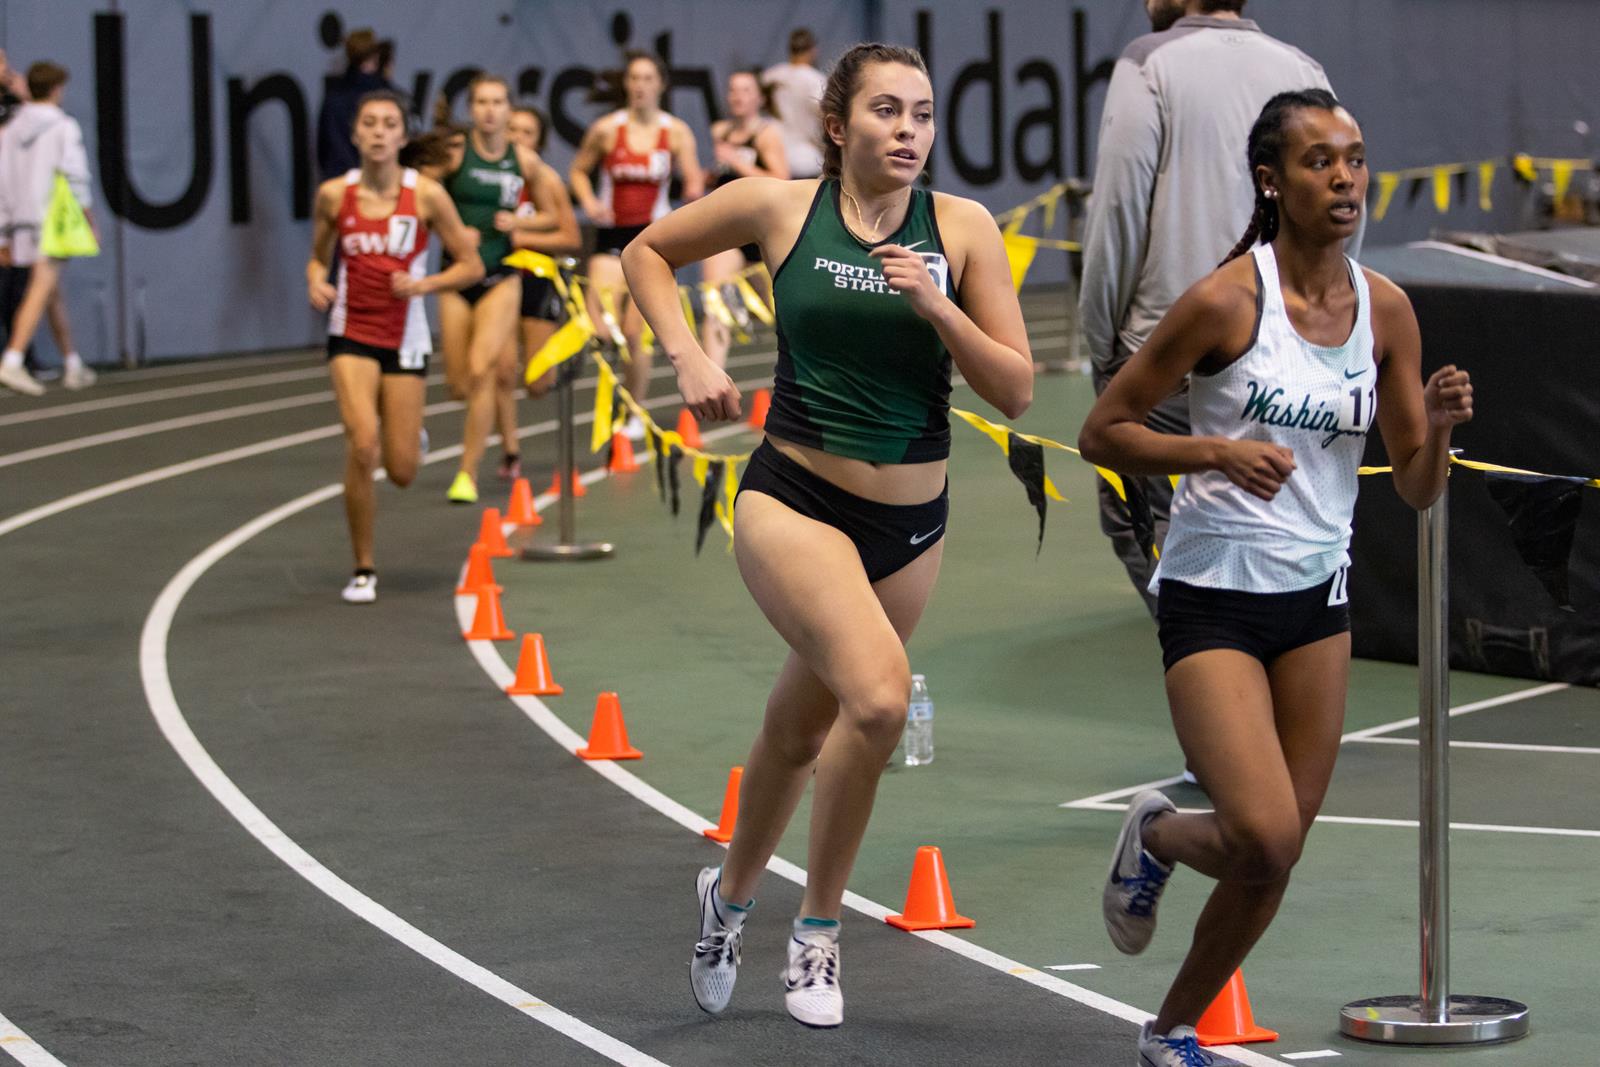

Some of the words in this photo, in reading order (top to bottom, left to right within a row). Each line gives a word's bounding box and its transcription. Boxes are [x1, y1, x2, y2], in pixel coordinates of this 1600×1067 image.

[917, 9, 1120, 187] Idah
[342, 232, 388, 255] EW
[397, 220, 410, 251] 7
[813, 257, 884, 280] PORTL
[1240, 381, 1366, 449] Washing
